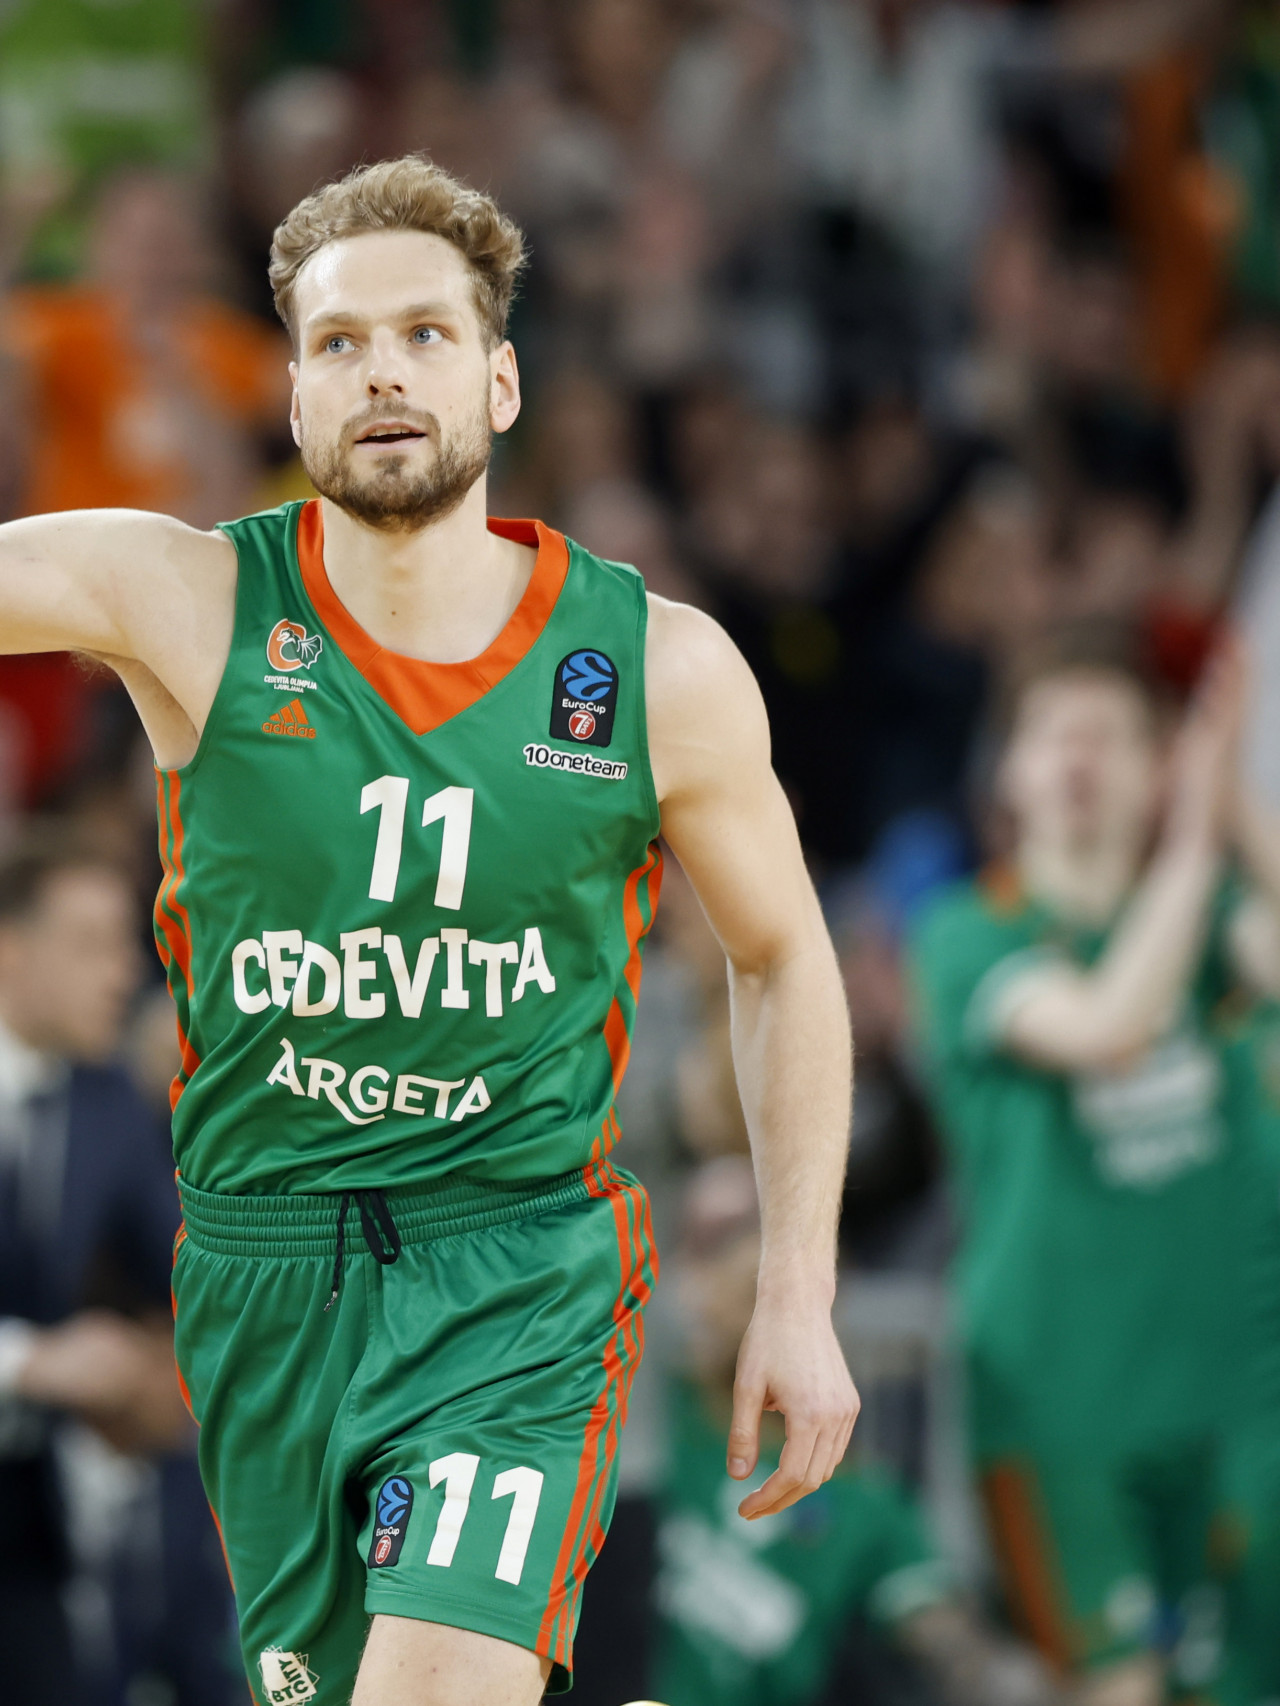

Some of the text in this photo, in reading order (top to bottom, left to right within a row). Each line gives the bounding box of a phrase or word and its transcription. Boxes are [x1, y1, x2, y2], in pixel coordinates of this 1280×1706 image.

[562, 698, 606, 715] EuroCup
[262, 721, 316, 739] adidas
[574, 714, 589, 735] 7
[524, 745, 627, 778] 10oneteam
[359, 774, 474, 911] 11
[231, 926, 556, 1020] CEDEVITA
[266, 1037, 492, 1126] ARGETA
[375, 1526, 400, 1537] EuroCup
[426, 1452, 544, 1586] 11
